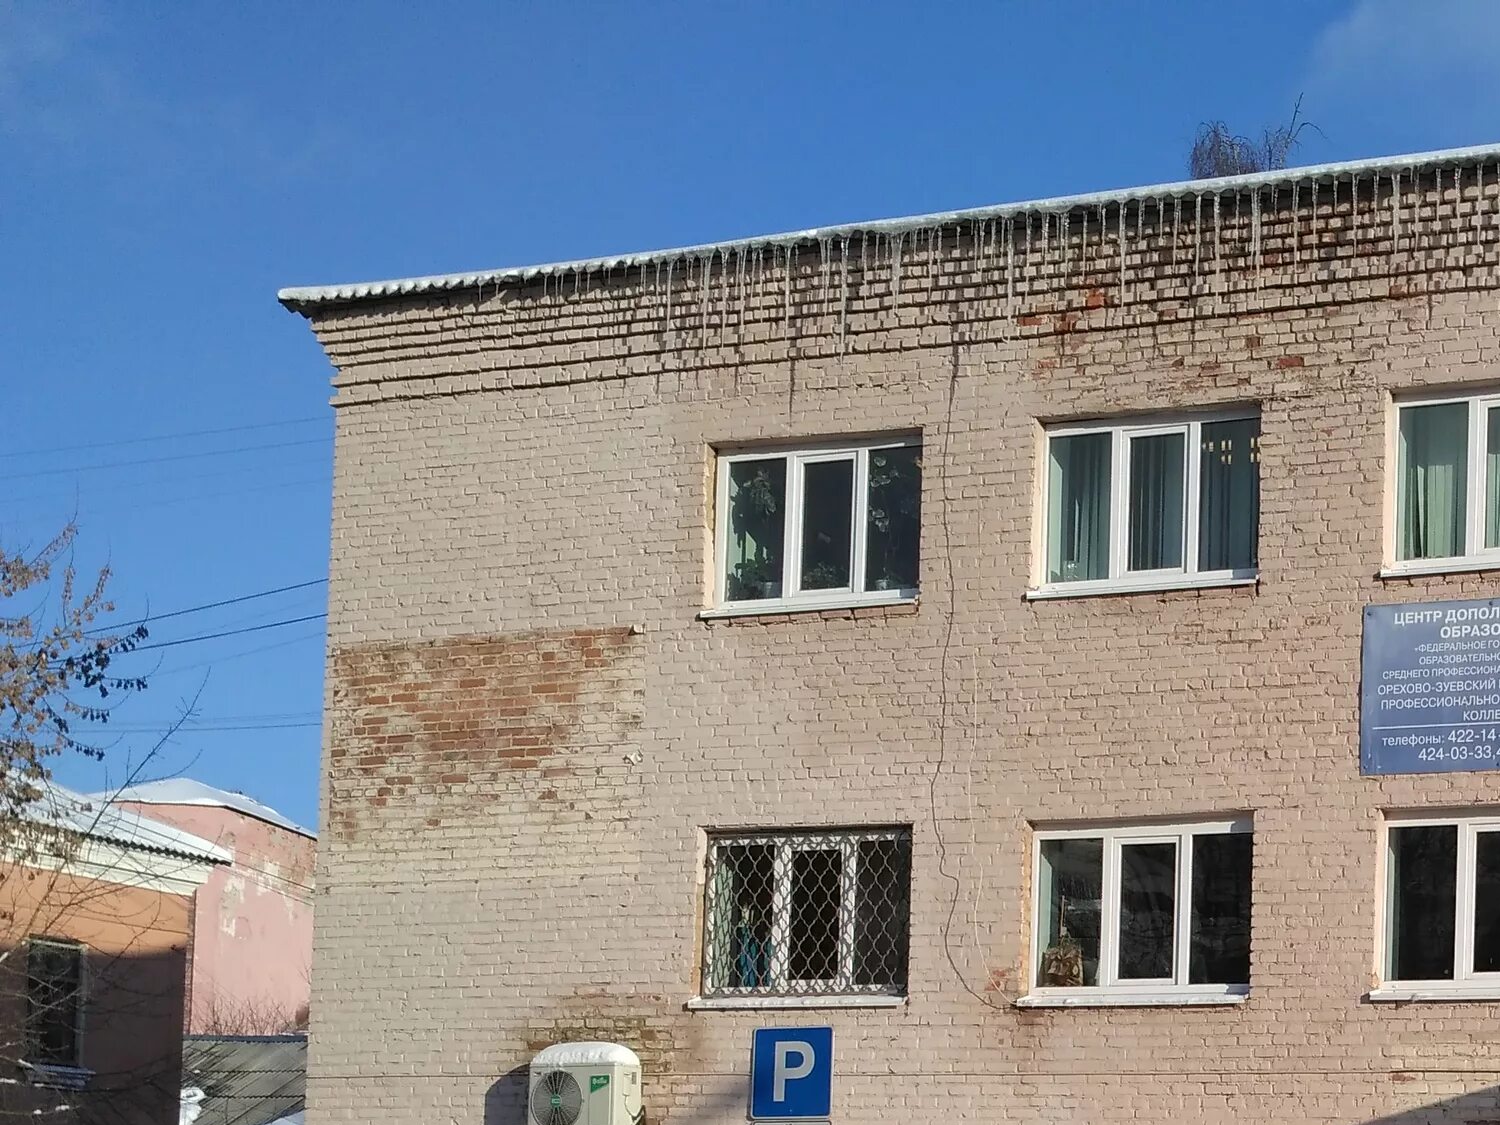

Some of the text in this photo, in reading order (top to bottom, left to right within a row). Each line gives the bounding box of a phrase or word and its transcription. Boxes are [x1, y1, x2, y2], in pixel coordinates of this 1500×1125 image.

[1394, 610, 1442, 627] ЦЕНТР
[1414, 639, 1487, 653] «ФЕДЕРАЛЬНОЕ
[1382, 668, 1430, 680] СРЕДНЕГО
[1377, 677, 1496, 695] ОРЕХОВО-ЗУЕВСКИЙ
[1381, 733, 1445, 747] телефоны:
[773, 1041, 815, 1102] P
